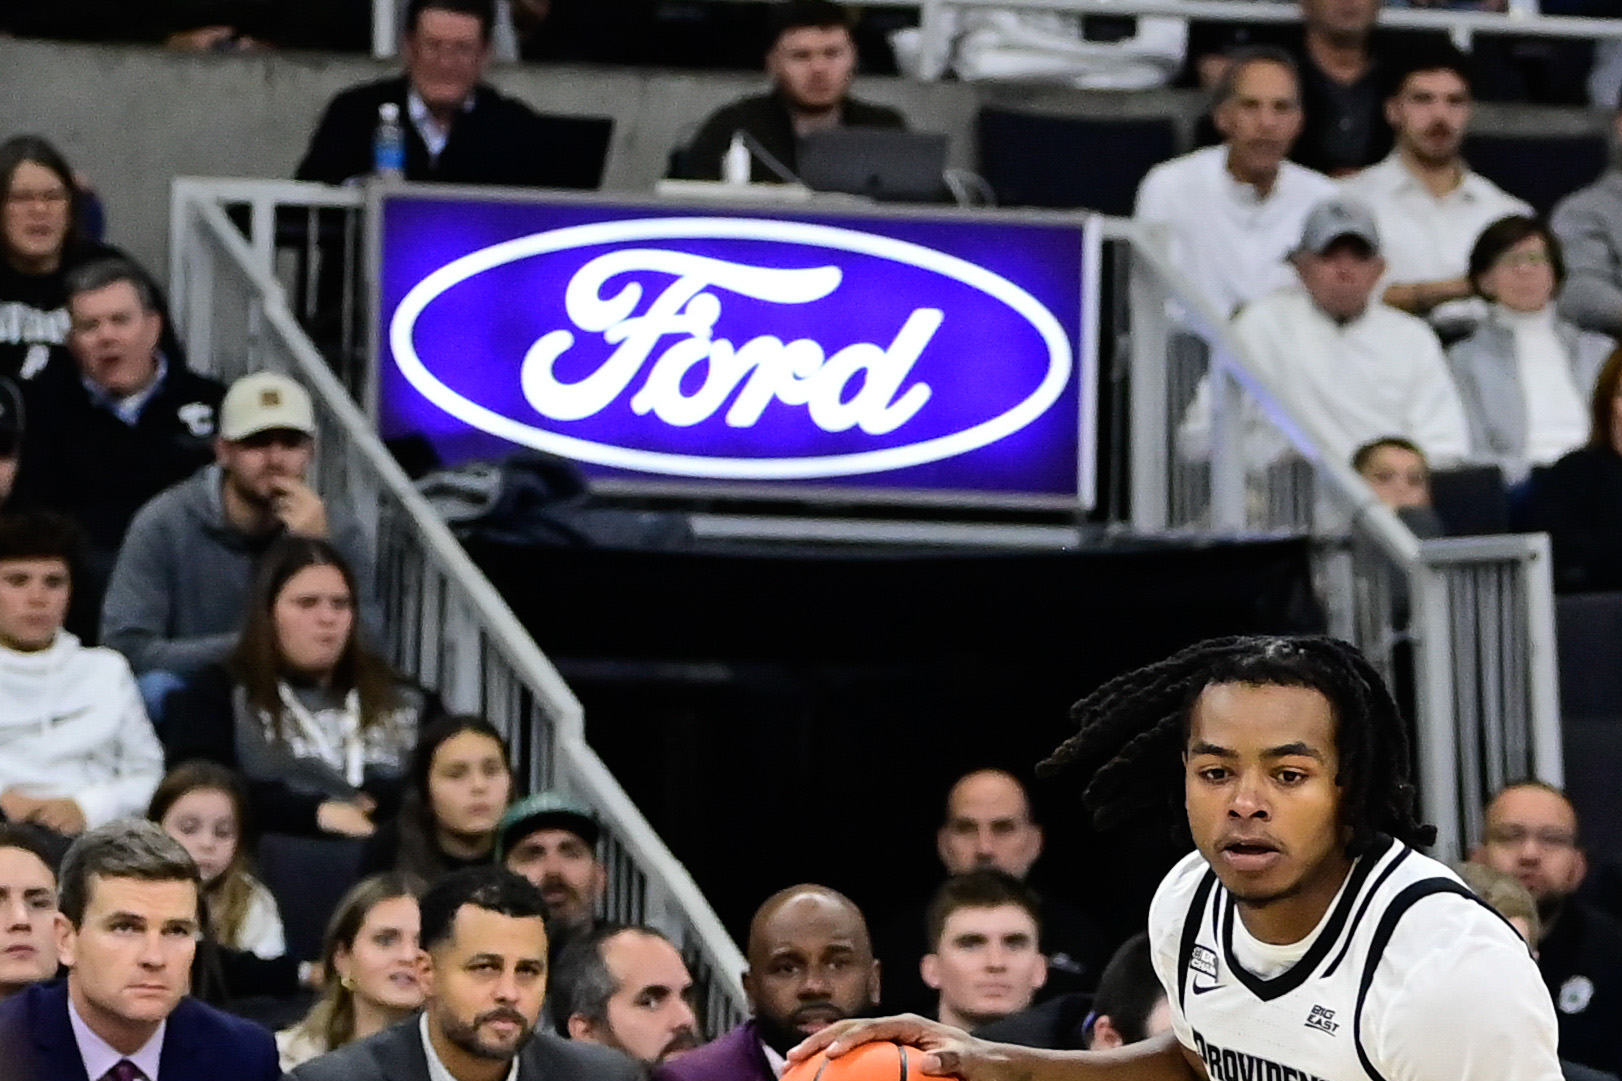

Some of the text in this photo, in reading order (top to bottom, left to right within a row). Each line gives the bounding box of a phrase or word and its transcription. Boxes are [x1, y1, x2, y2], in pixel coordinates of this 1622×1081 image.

[521, 249, 944, 435] Ford
[1311, 1004, 1336, 1020] BIG
[1307, 1013, 1340, 1032] EAST
